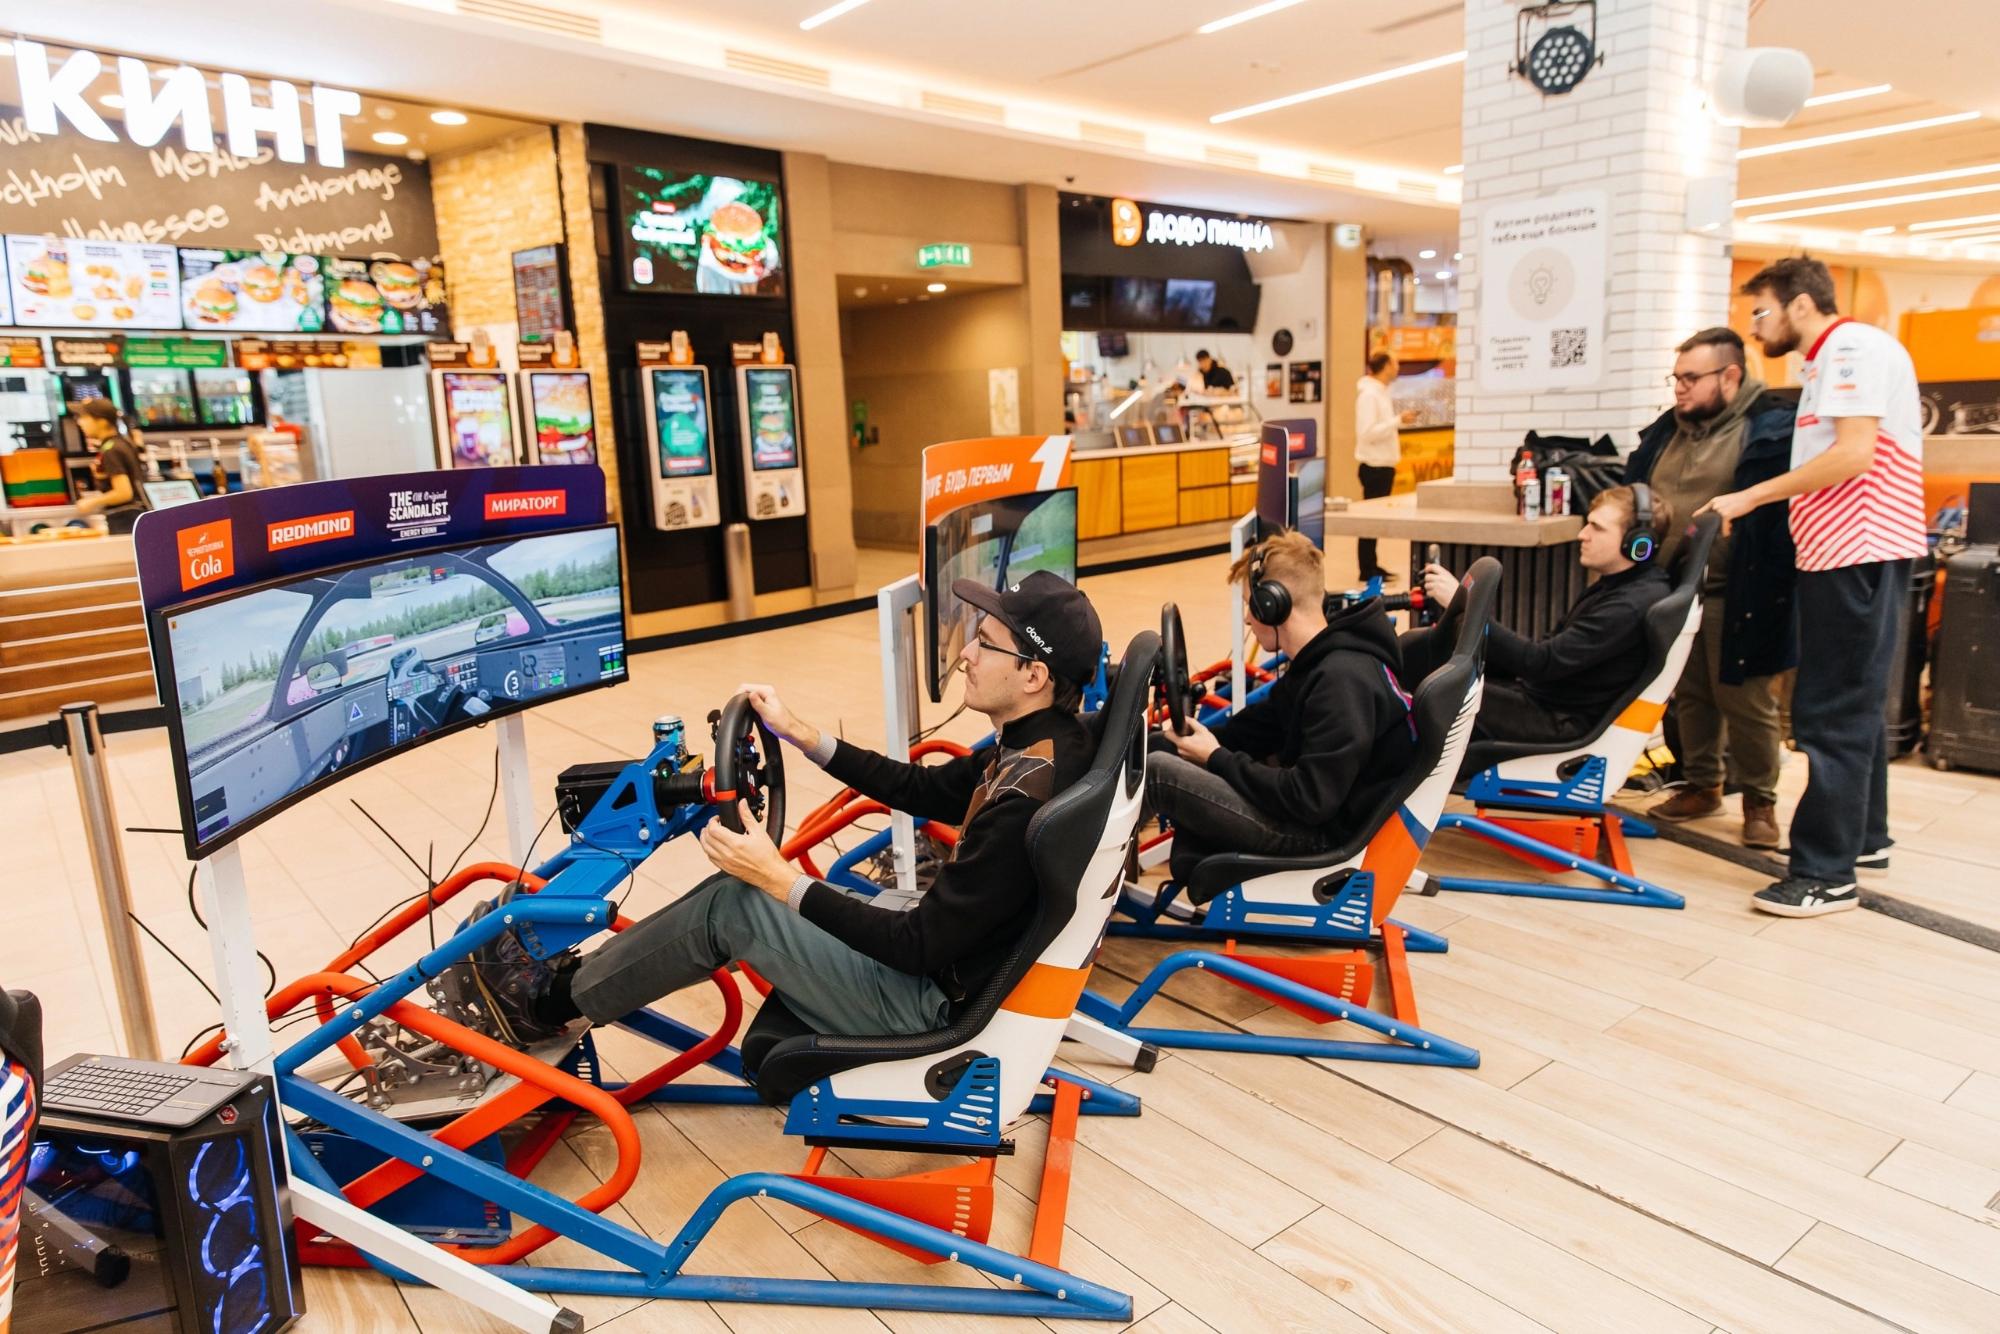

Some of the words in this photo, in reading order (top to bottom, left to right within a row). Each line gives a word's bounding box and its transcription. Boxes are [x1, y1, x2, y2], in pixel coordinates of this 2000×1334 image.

[13, 39, 361, 168] КИНГ
[254, 163, 402, 212] Anchorage
[1146, 212, 1206, 247] ДОДО
[1206, 218, 1274, 253] ПИЦЦА
[944, 468, 968, 494] БУДЬ
[967, 463, 1014, 488] ПЕРВЫМ
[1029, 435, 1073, 491] 1
[389, 490, 413, 508] THE
[389, 501, 449, 522] SCANDALIST
[491, 496, 560, 513] МИРАТОРГ
[190, 554, 223, 581] Cola
